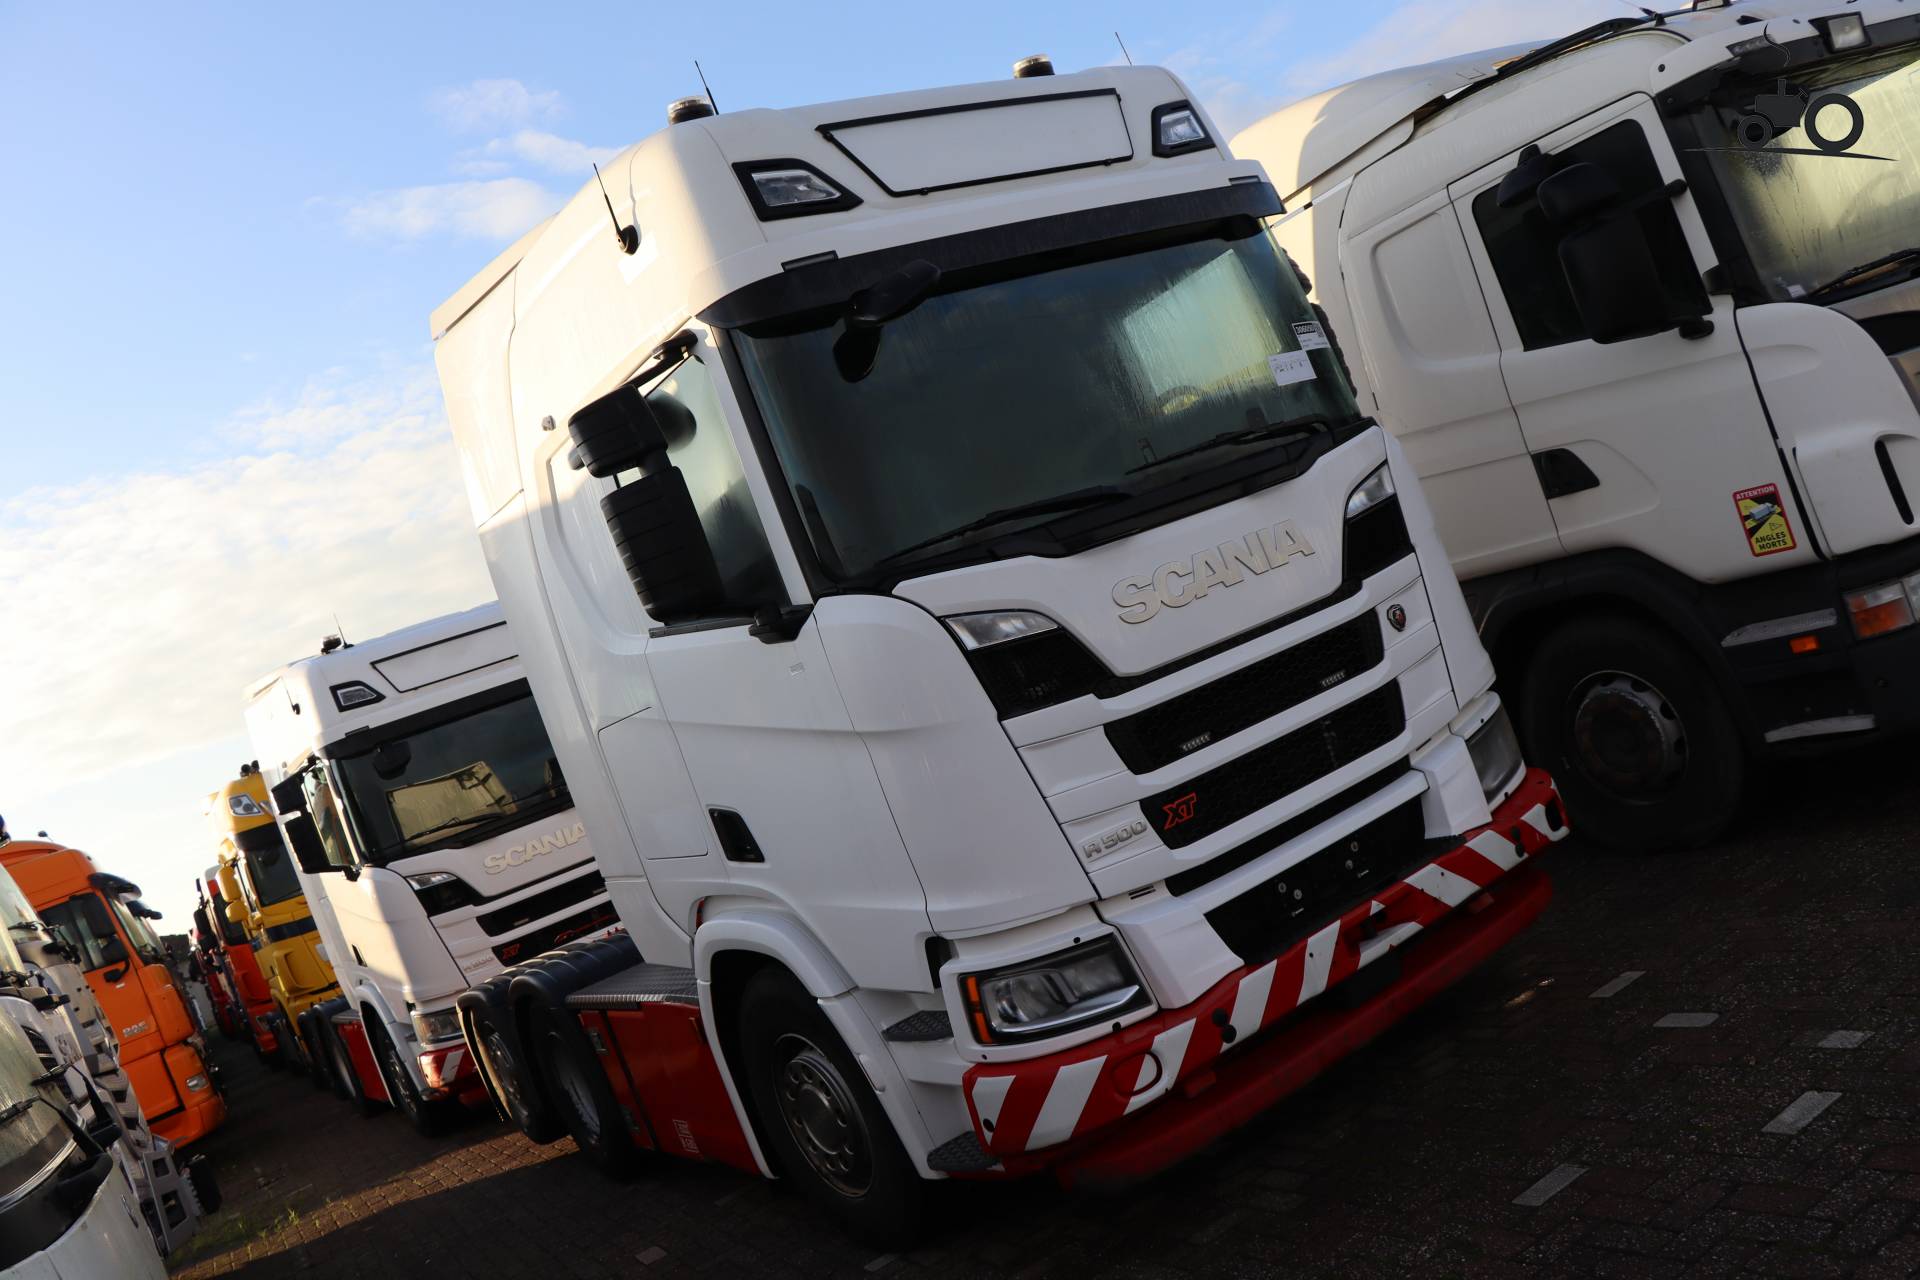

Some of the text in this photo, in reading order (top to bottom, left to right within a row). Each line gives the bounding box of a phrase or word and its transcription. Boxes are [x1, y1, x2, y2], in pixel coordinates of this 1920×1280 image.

[1736, 485, 1775, 499] ATTENTION
[1755, 532, 1786, 544] ANGLES
[1759, 539, 1787, 550] MORTS
[1112, 519, 1315, 625] SCANIA
[1162, 792, 1197, 830] XT
[484, 823, 586, 874] SCANIA
